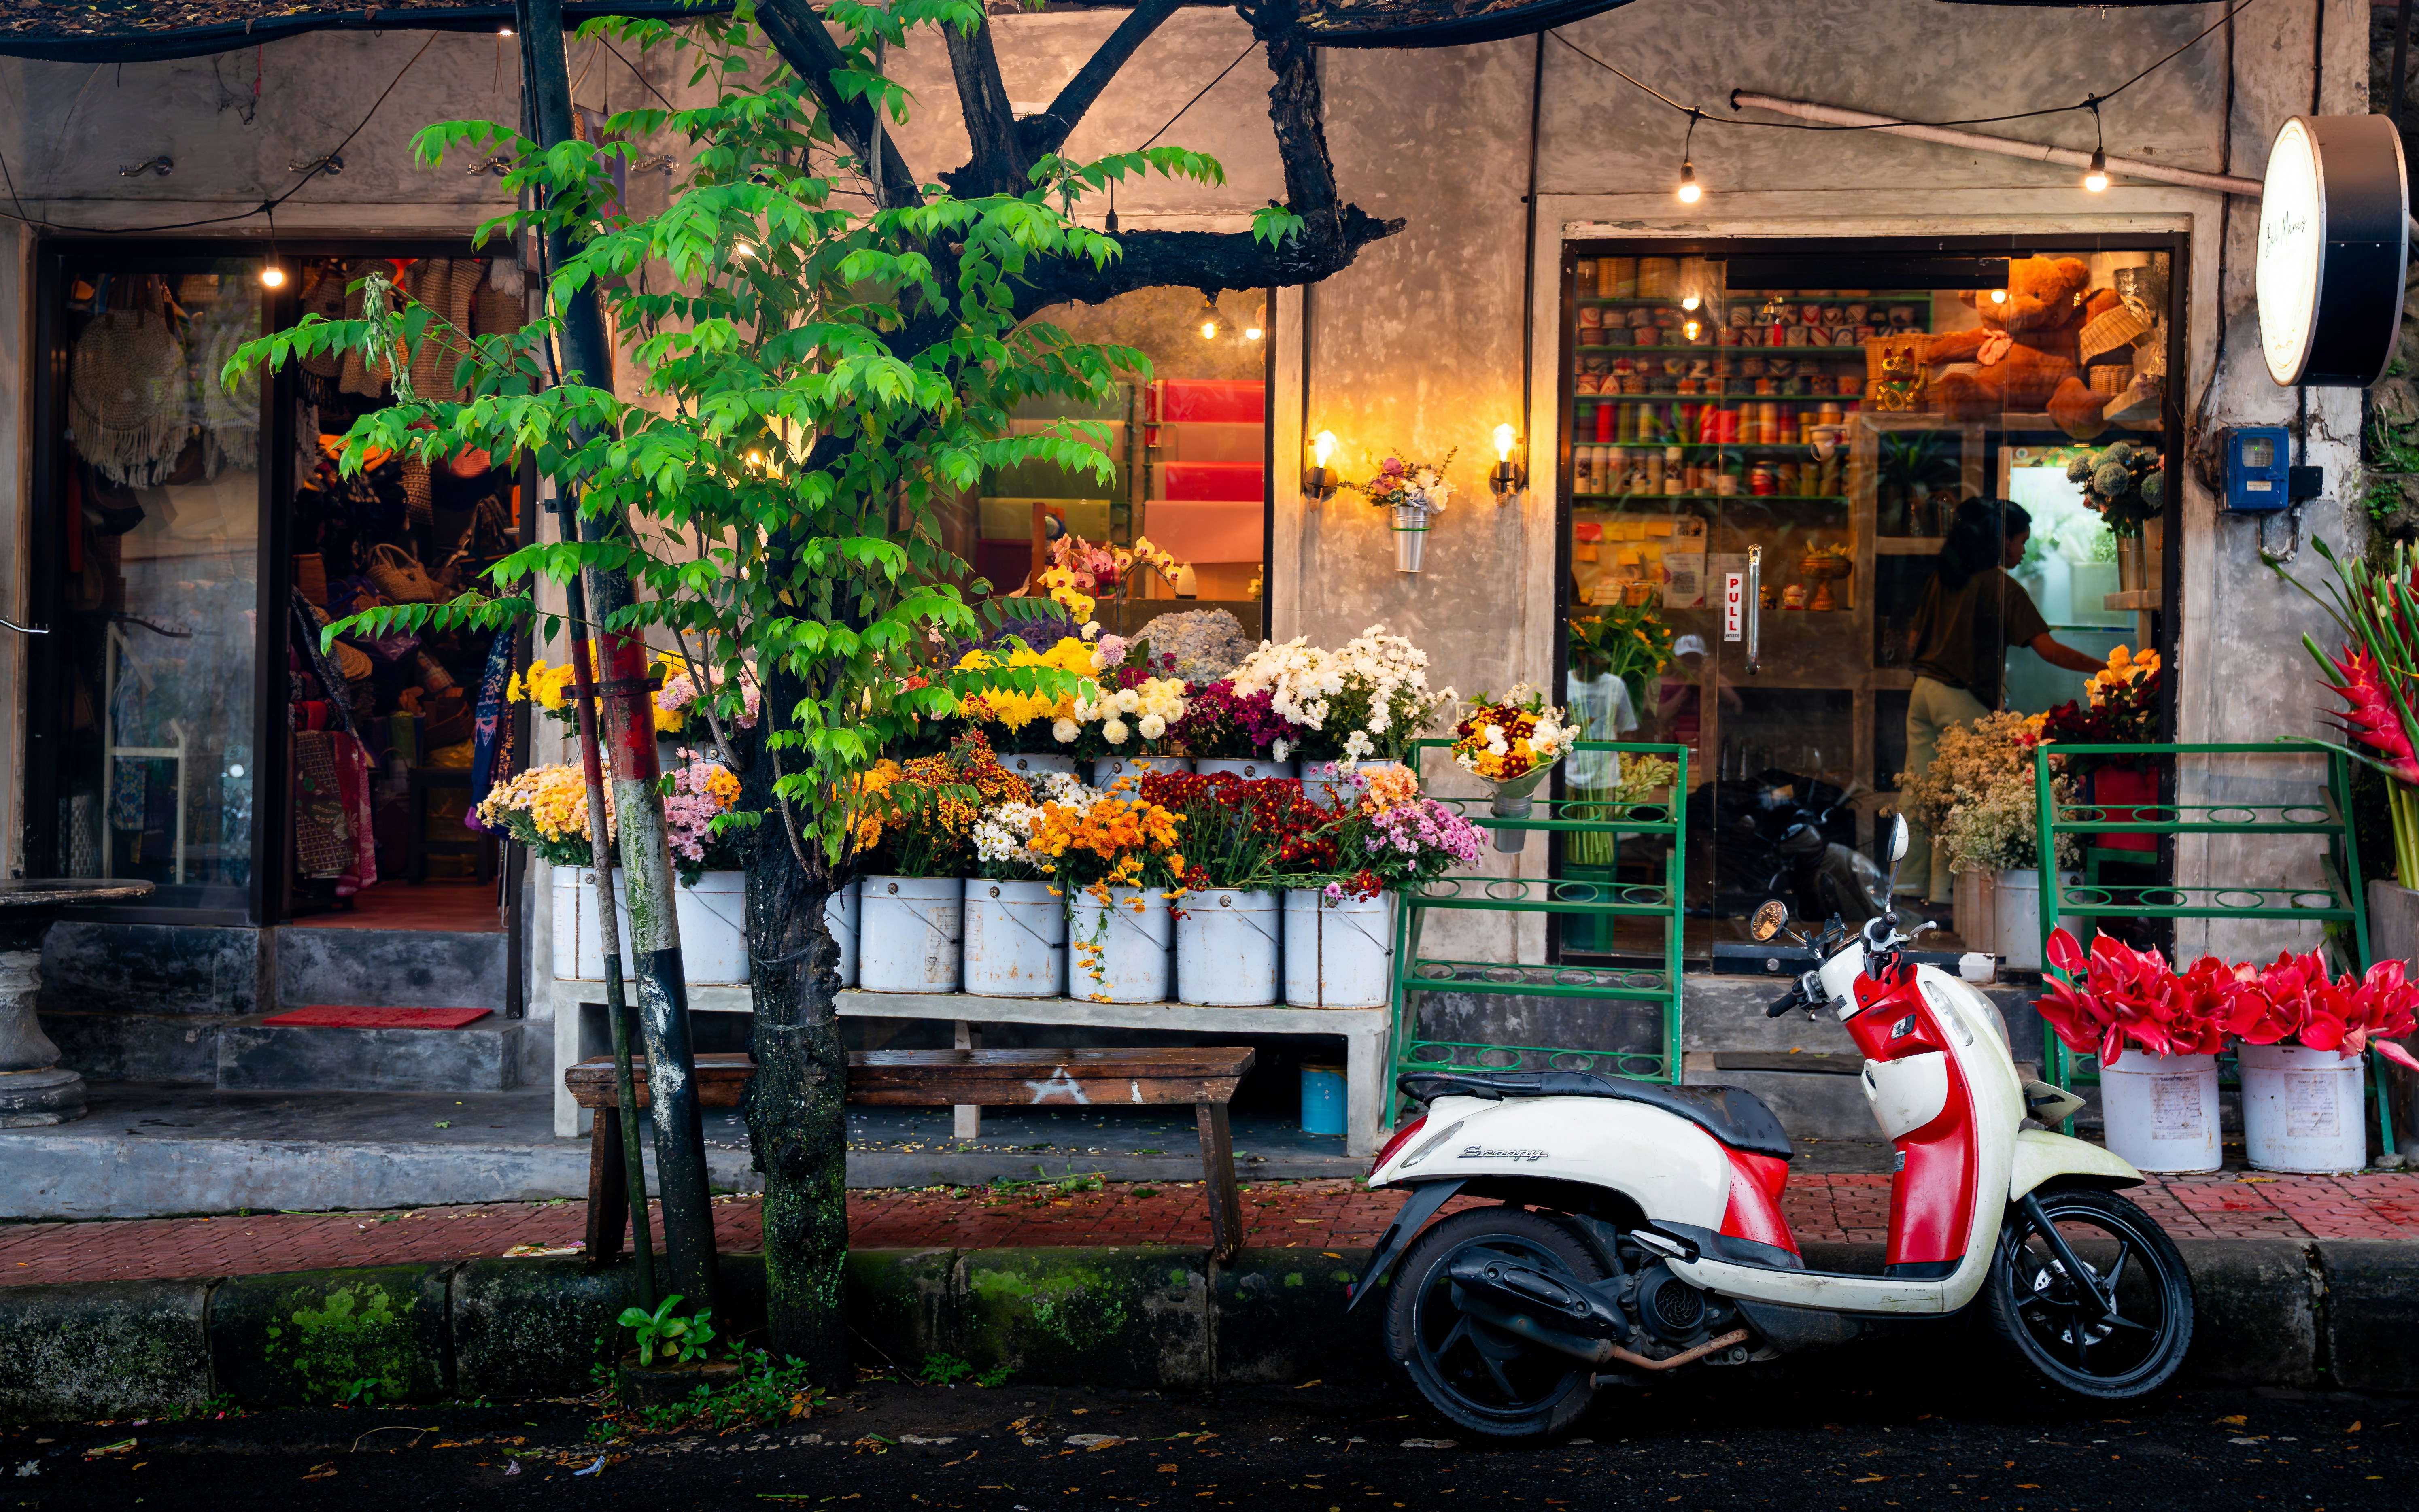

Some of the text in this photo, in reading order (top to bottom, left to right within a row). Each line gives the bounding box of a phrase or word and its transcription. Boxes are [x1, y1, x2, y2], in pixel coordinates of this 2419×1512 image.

[2281, 210, 2307, 246] Manis
[1729, 578, 1739, 631] PULL
[1457, 1144, 1548, 1162] Scoopy
